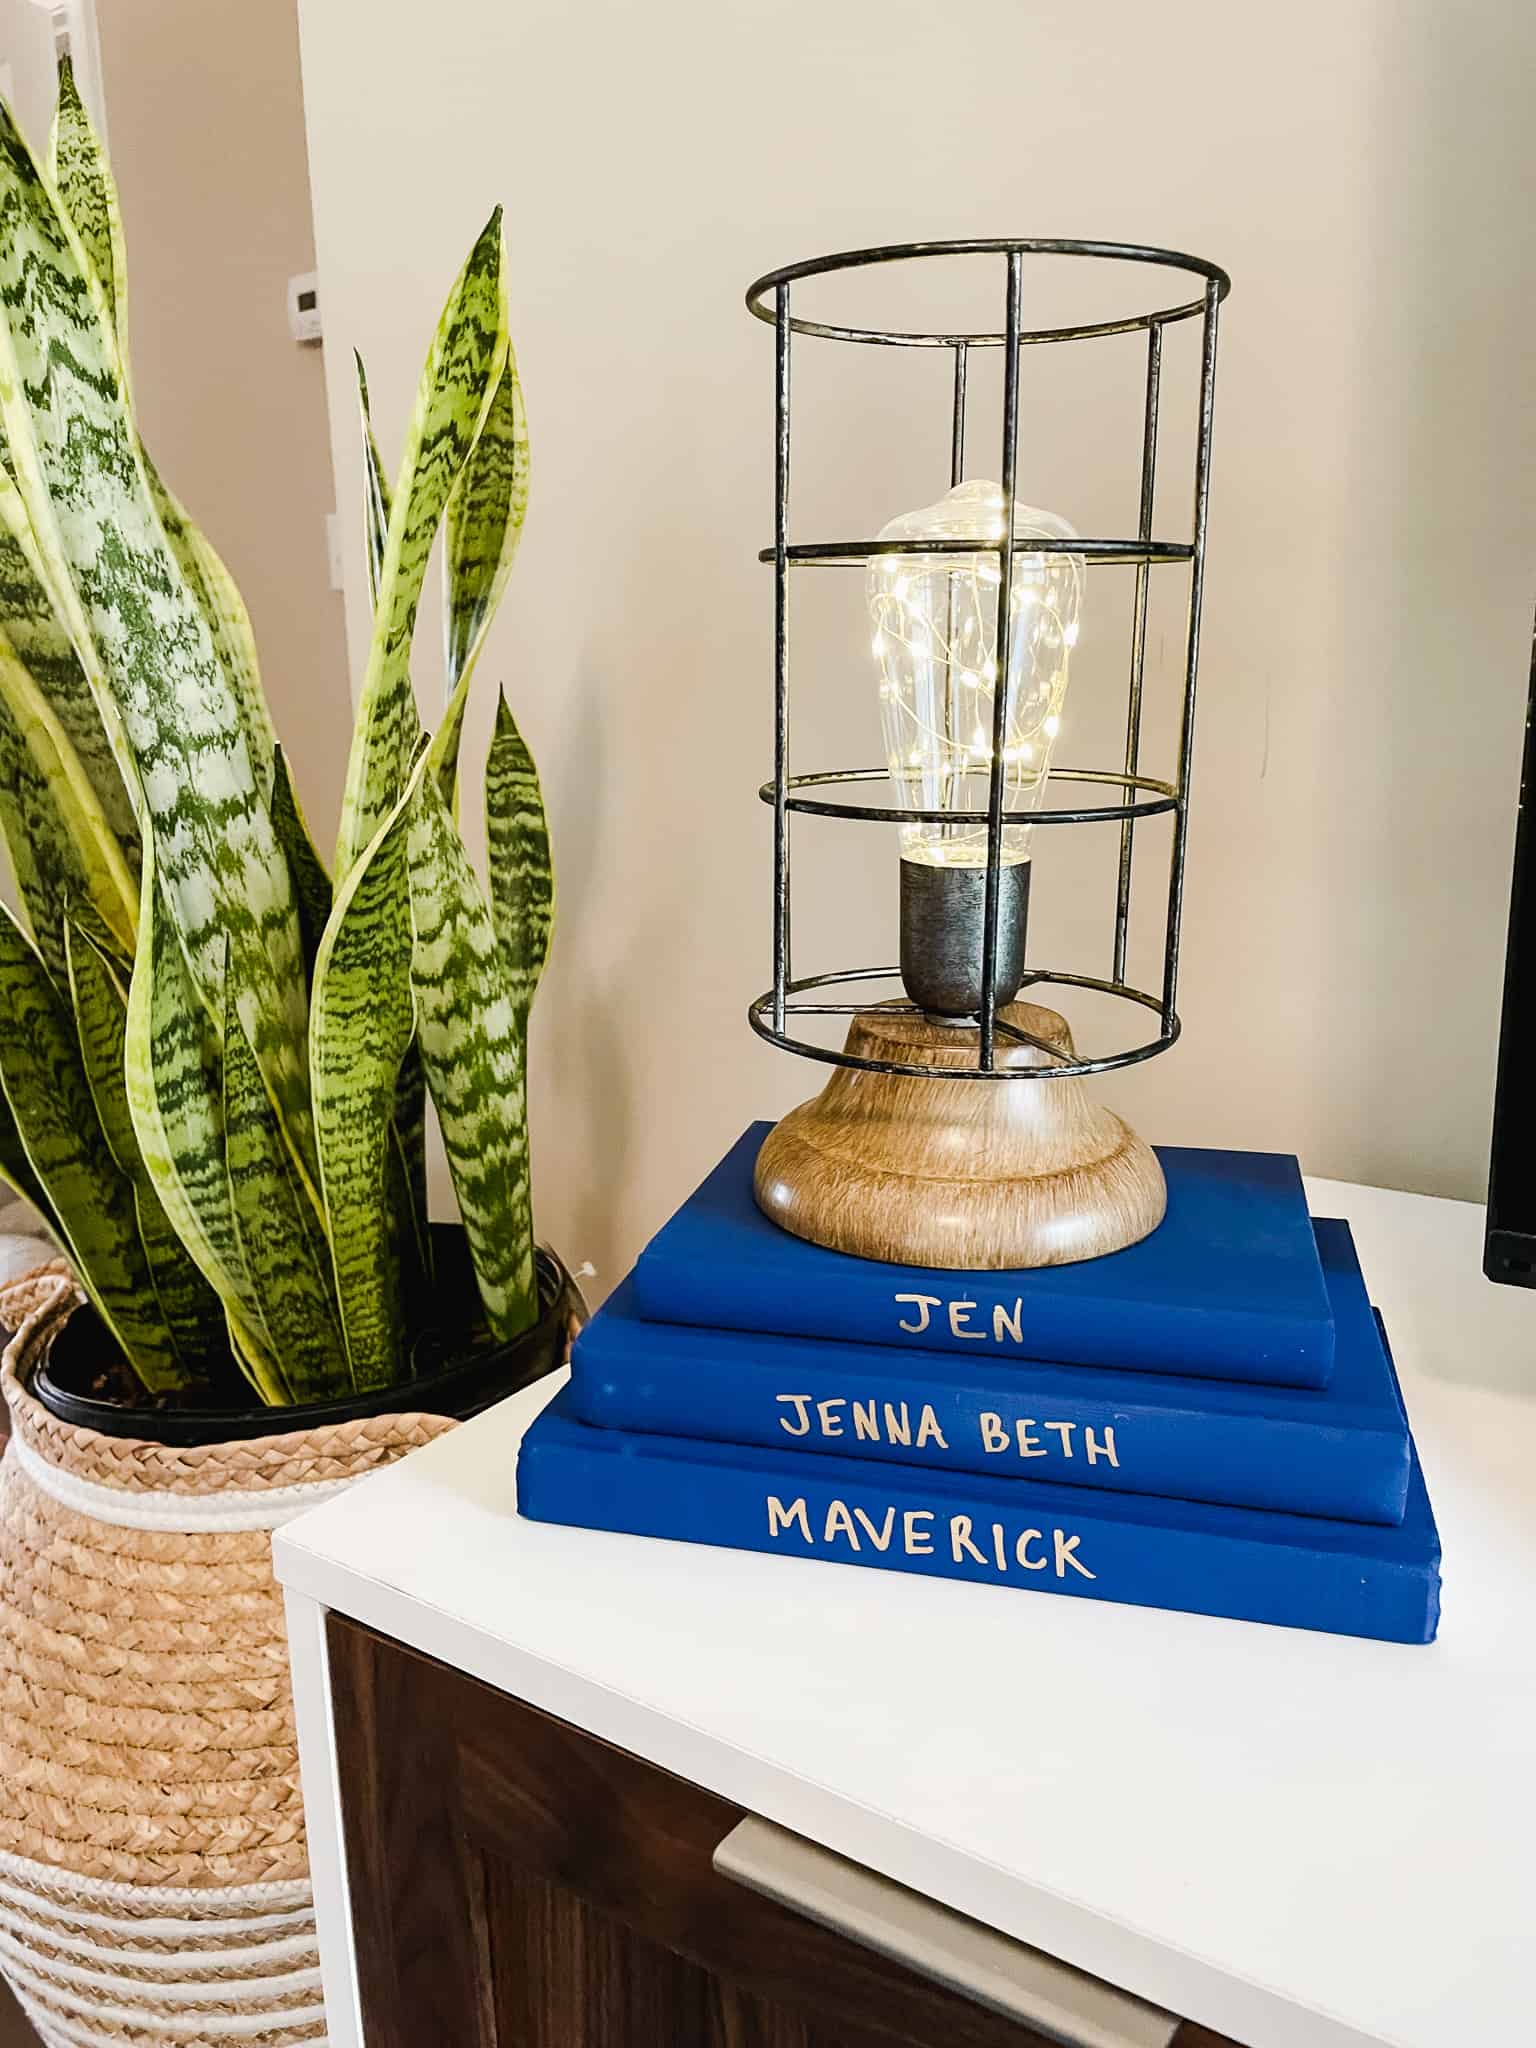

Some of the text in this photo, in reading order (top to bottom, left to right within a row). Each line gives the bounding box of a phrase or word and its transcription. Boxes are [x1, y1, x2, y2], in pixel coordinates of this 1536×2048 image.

[894, 1293, 1023, 1343] JEN
[775, 1393, 1121, 1467] JENNA BETH
[766, 1495, 1097, 1579] MAVERICK
